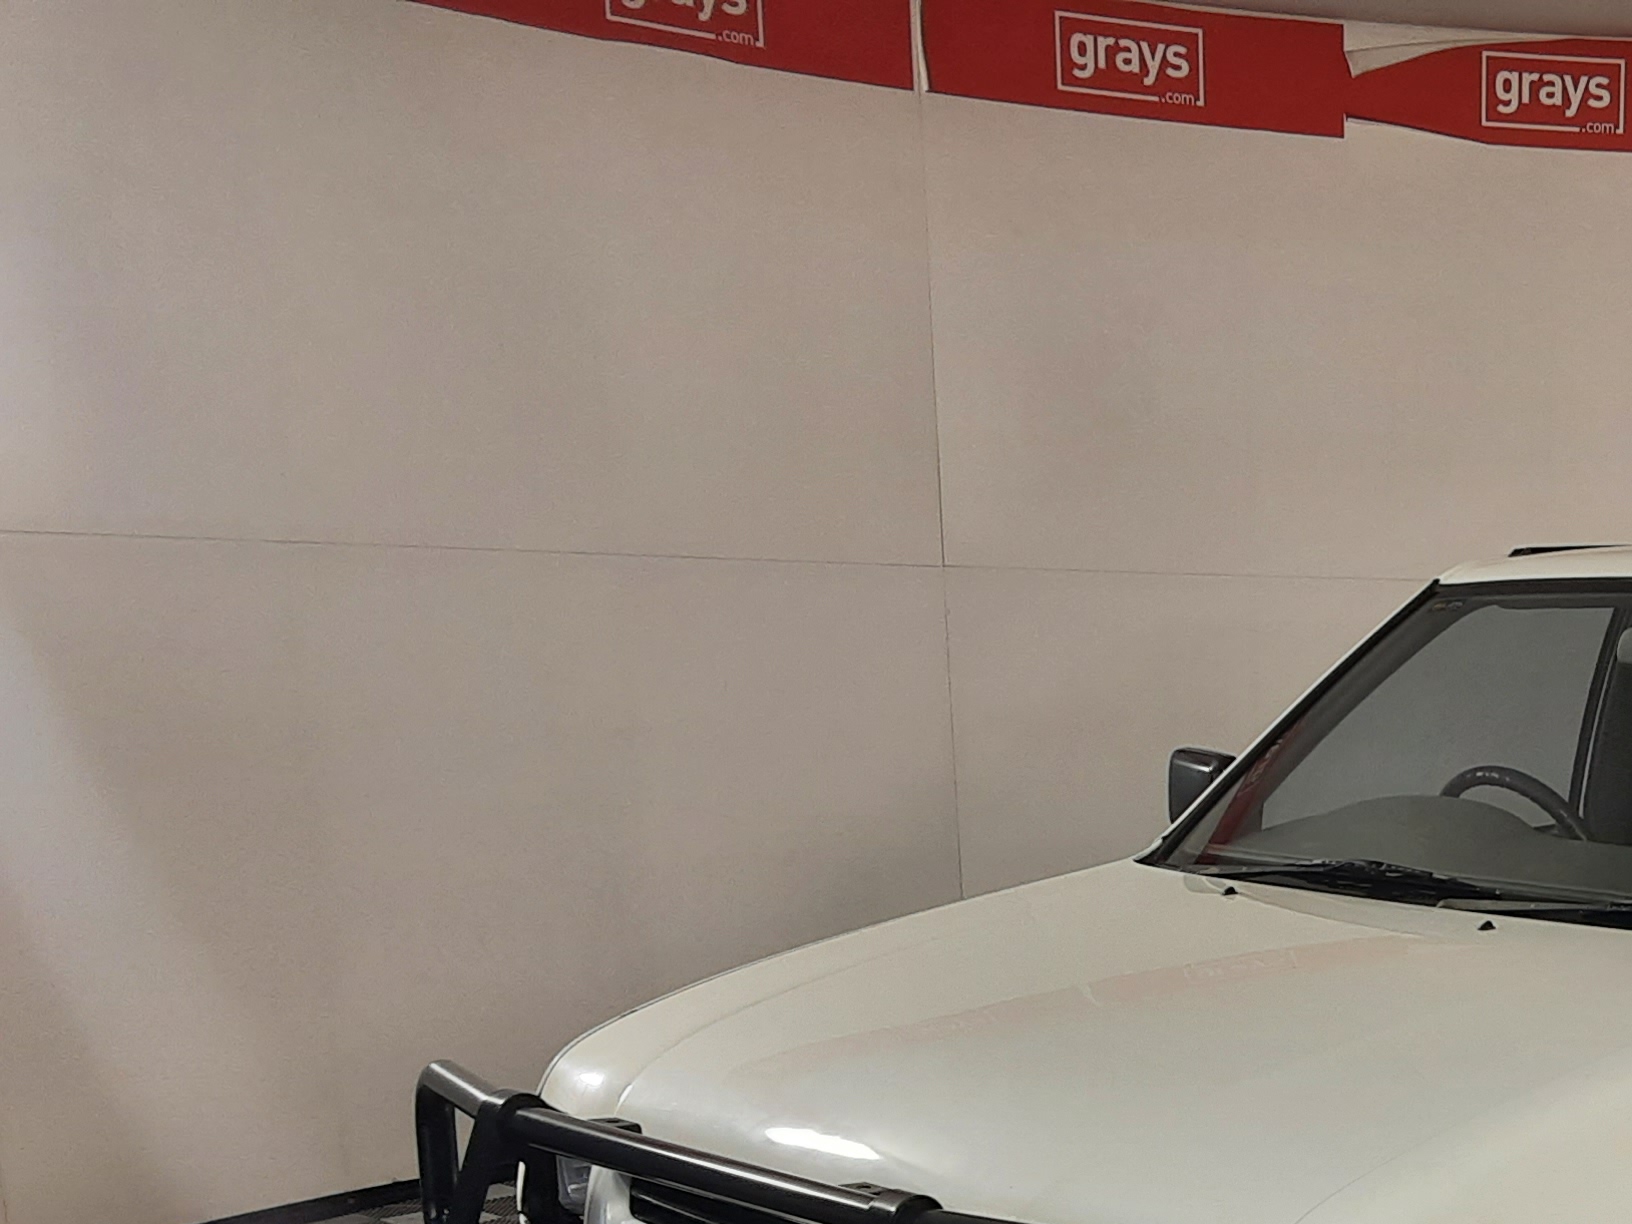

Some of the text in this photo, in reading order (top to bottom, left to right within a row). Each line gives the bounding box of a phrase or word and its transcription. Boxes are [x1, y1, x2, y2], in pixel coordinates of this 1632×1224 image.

[717, 30, 755, 46] .com
[1069, 32, 1190, 86] grays
[1161, 91, 1195, 106] .com
[1495, 69, 1612, 118] grays
[1581, 121, 1615, 134] .com
